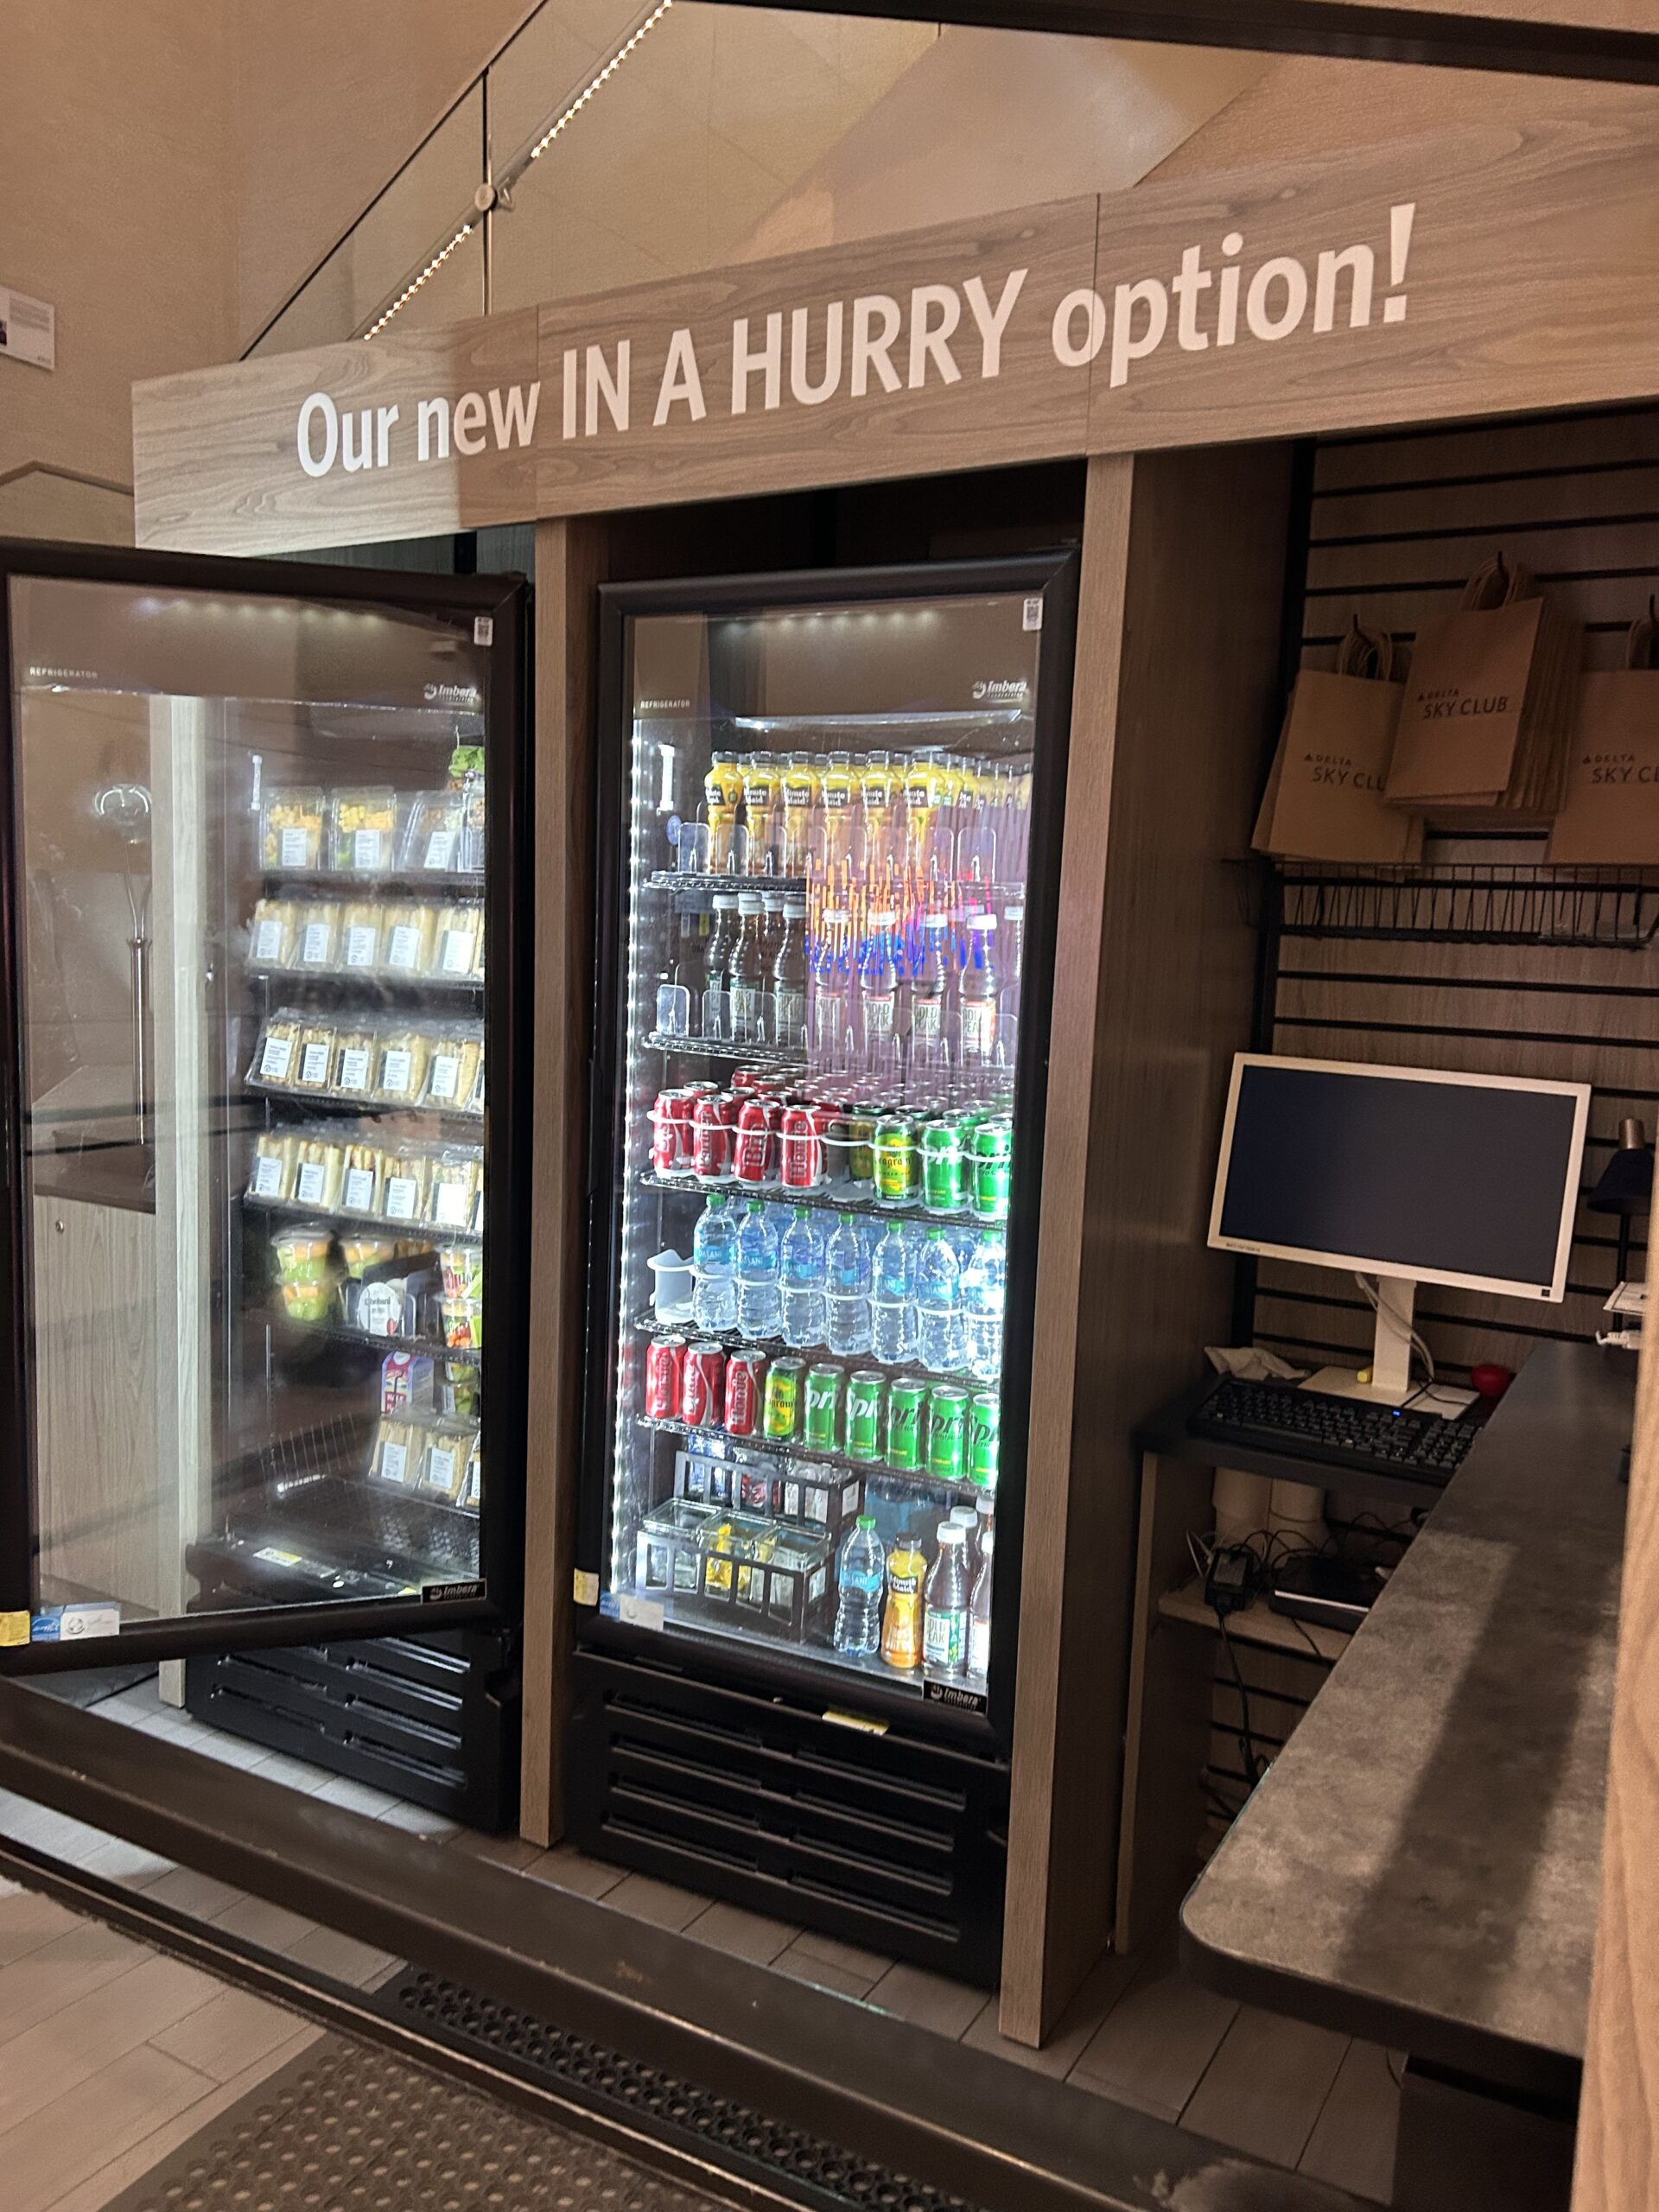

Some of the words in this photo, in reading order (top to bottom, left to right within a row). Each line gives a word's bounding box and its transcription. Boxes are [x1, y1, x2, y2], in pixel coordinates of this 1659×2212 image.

[297, 391, 400, 478] Our
[417, 381, 541, 456] new
[563, 340, 631, 440] IN
[652, 329, 707, 426] A
[731, 269, 1029, 416] HURRY
[1052, 203, 1415, 388] option!
[1427, 688, 1460, 699] DELTA
[640, 698, 690, 709] REFRIGERATOR
[1423, 700, 1457, 719] SKY
[1459, 696, 1508, 715] CLUB
[1316, 754, 1352, 766] DELTA
[1594, 753, 1637, 764] DELTA
[1313, 766, 1350, 785] SKY
[1352, 772, 1388, 792] CLU
[1591, 766, 1632, 784] SKY
[1638, 766, 1659, 784] CL
